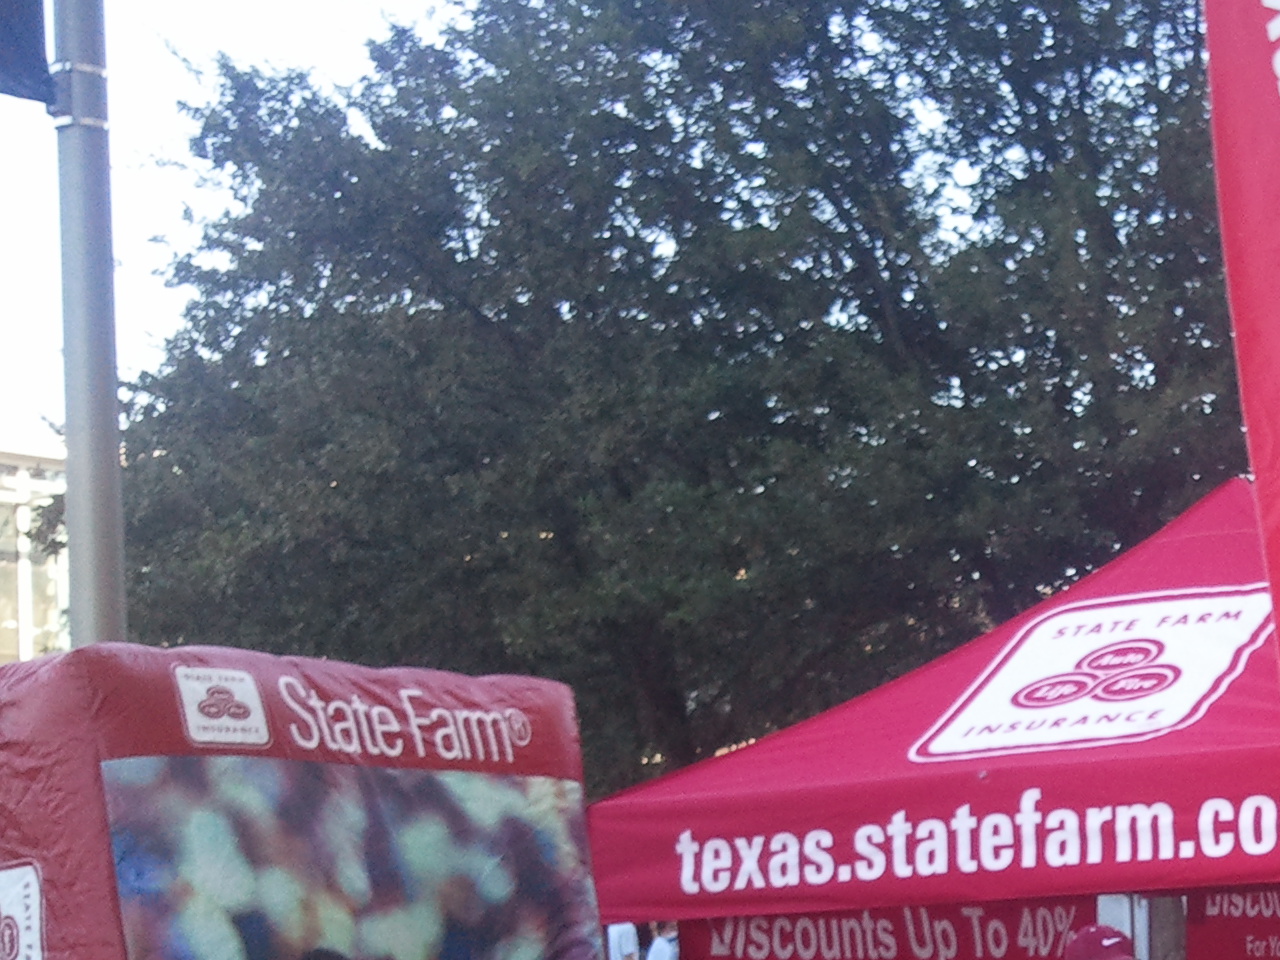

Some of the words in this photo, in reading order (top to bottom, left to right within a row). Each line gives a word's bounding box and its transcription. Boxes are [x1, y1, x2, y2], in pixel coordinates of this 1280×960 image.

[1051, 618, 1141, 639] STATE
[1156, 609, 1244, 629] FARM
[1032, 683, 1080, 700] Life
[1109, 677, 1160, 691] Fire
[961, 708, 1166, 738] INSURANCE
[961, 907, 1009, 958] To
[1017, 906, 1077, 958] 40%
[1245, 935, 1266, 956] For
